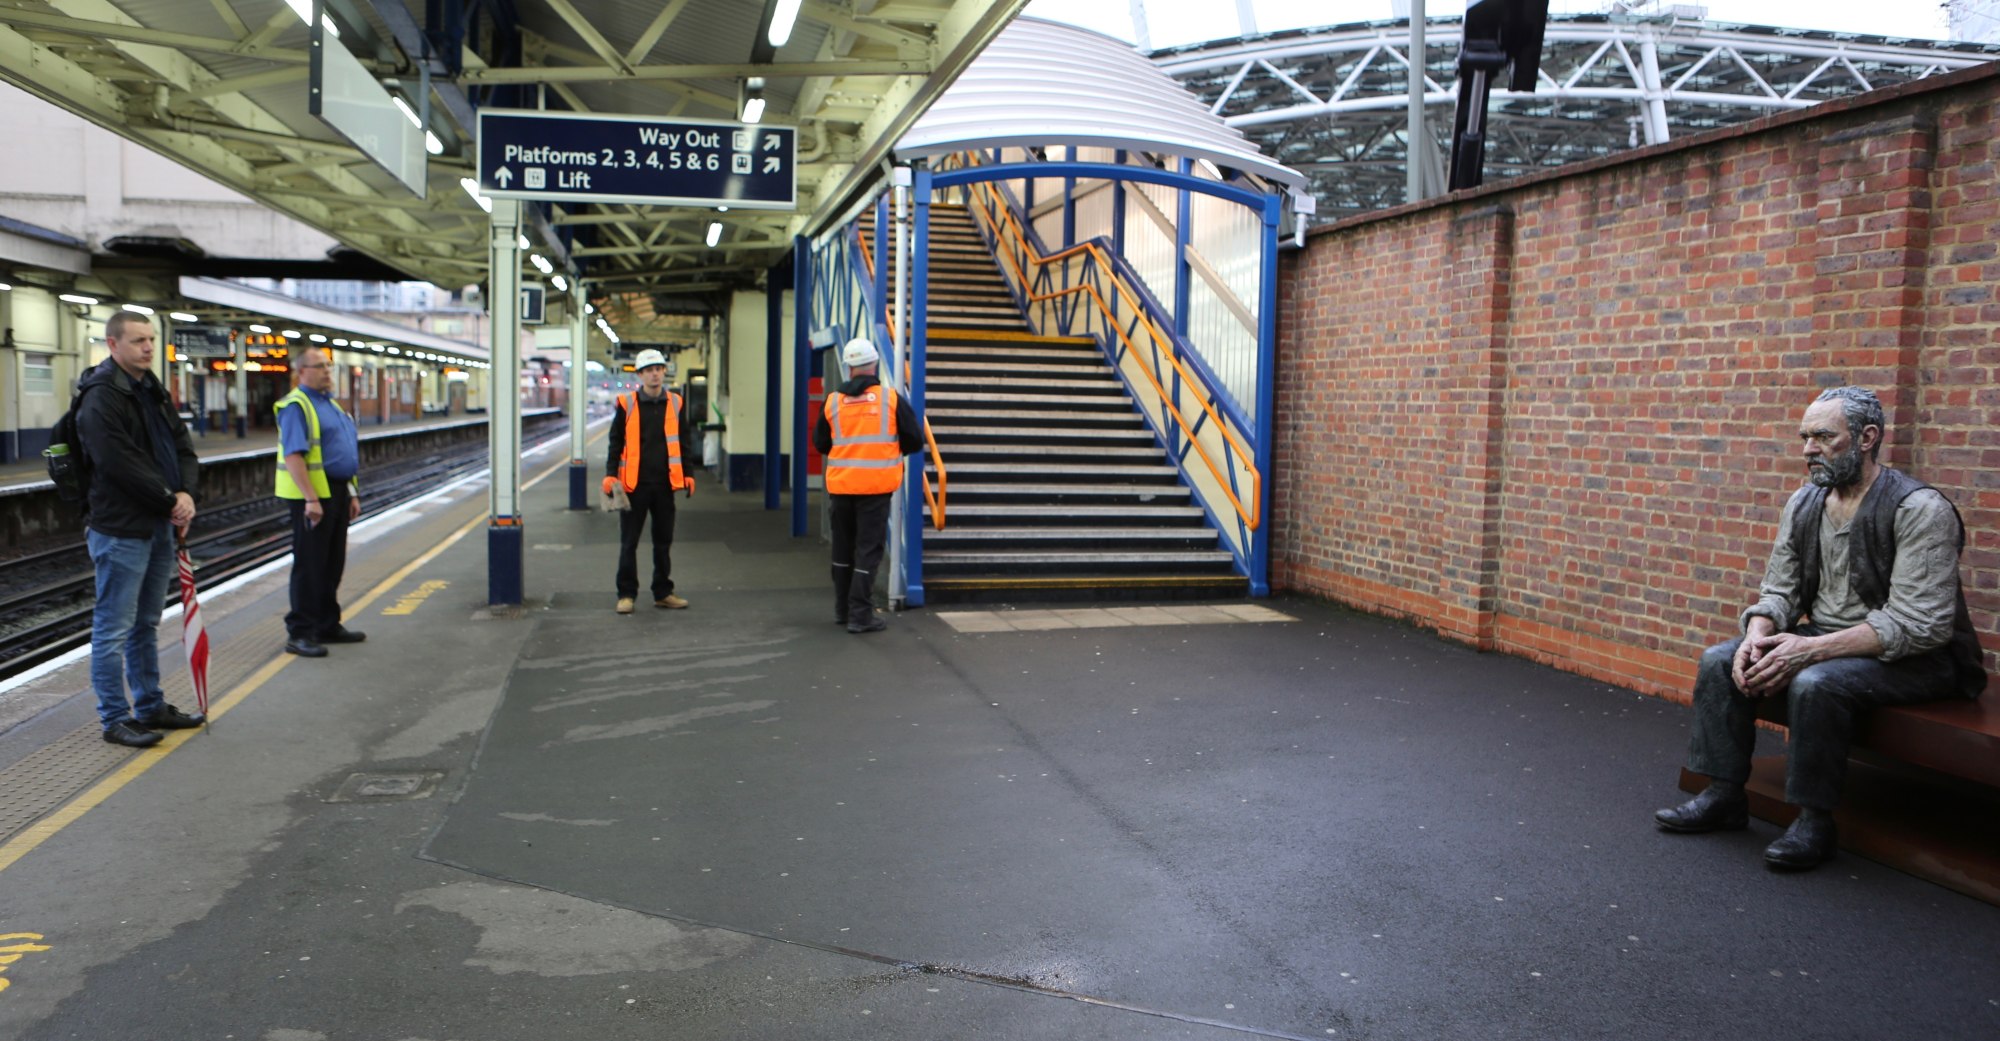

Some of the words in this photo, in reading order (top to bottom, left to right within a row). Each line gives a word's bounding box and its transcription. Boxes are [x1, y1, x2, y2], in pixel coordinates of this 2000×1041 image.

[639, 127, 680, 150] Way
[685, 129, 720, 149] Out
[505, 144, 597, 166] Platforms
[601, 148, 619, 169] 2,
[623, 149, 640, 170] 3,
[645, 151, 664, 171] 4,
[669, 151, 682, 170] 5
[686, 152, 702, 171] &
[706, 153, 720, 171] 6
[558, 170, 591, 189] Lift
